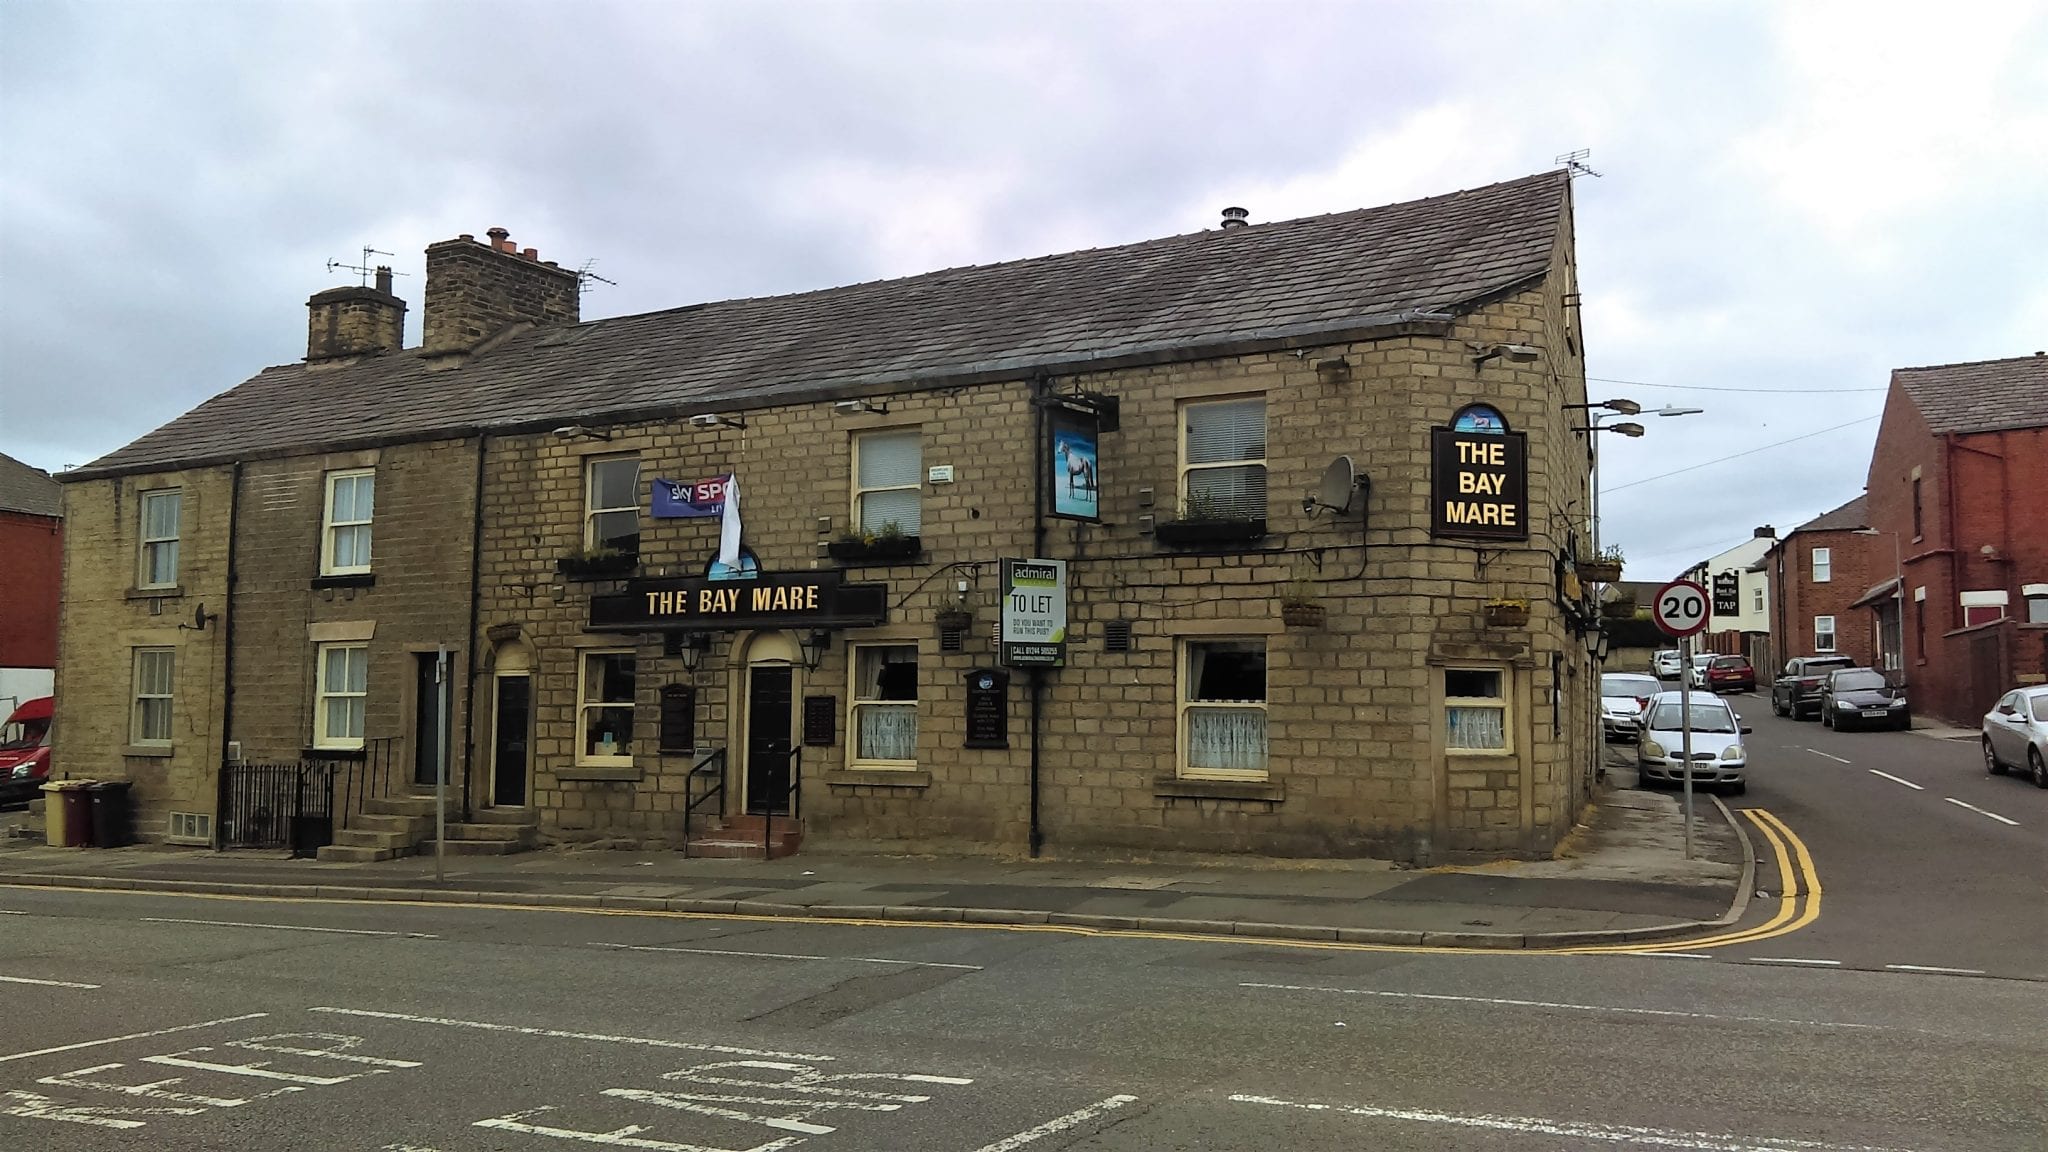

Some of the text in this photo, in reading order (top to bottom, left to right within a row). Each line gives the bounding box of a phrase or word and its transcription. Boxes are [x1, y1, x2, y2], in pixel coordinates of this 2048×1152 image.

[1455, 441, 1505, 465] THE
[1459, 471, 1506, 495] BAY
[671, 484, 692, 503] sky
[1446, 501, 1516, 526] MARE
[1014, 566, 1055, 580] admiral
[646, 585, 819, 615] THE BAY MARE
[1011, 594, 1053, 613] TO LET
[1663, 596, 1702, 618] 20
[1717, 601, 1736, 610] TAP
[1022, 619, 1031, 627] YOU
[1032, 619, 1045, 627] WANT
[1013, 646, 1024, 654] CALL
